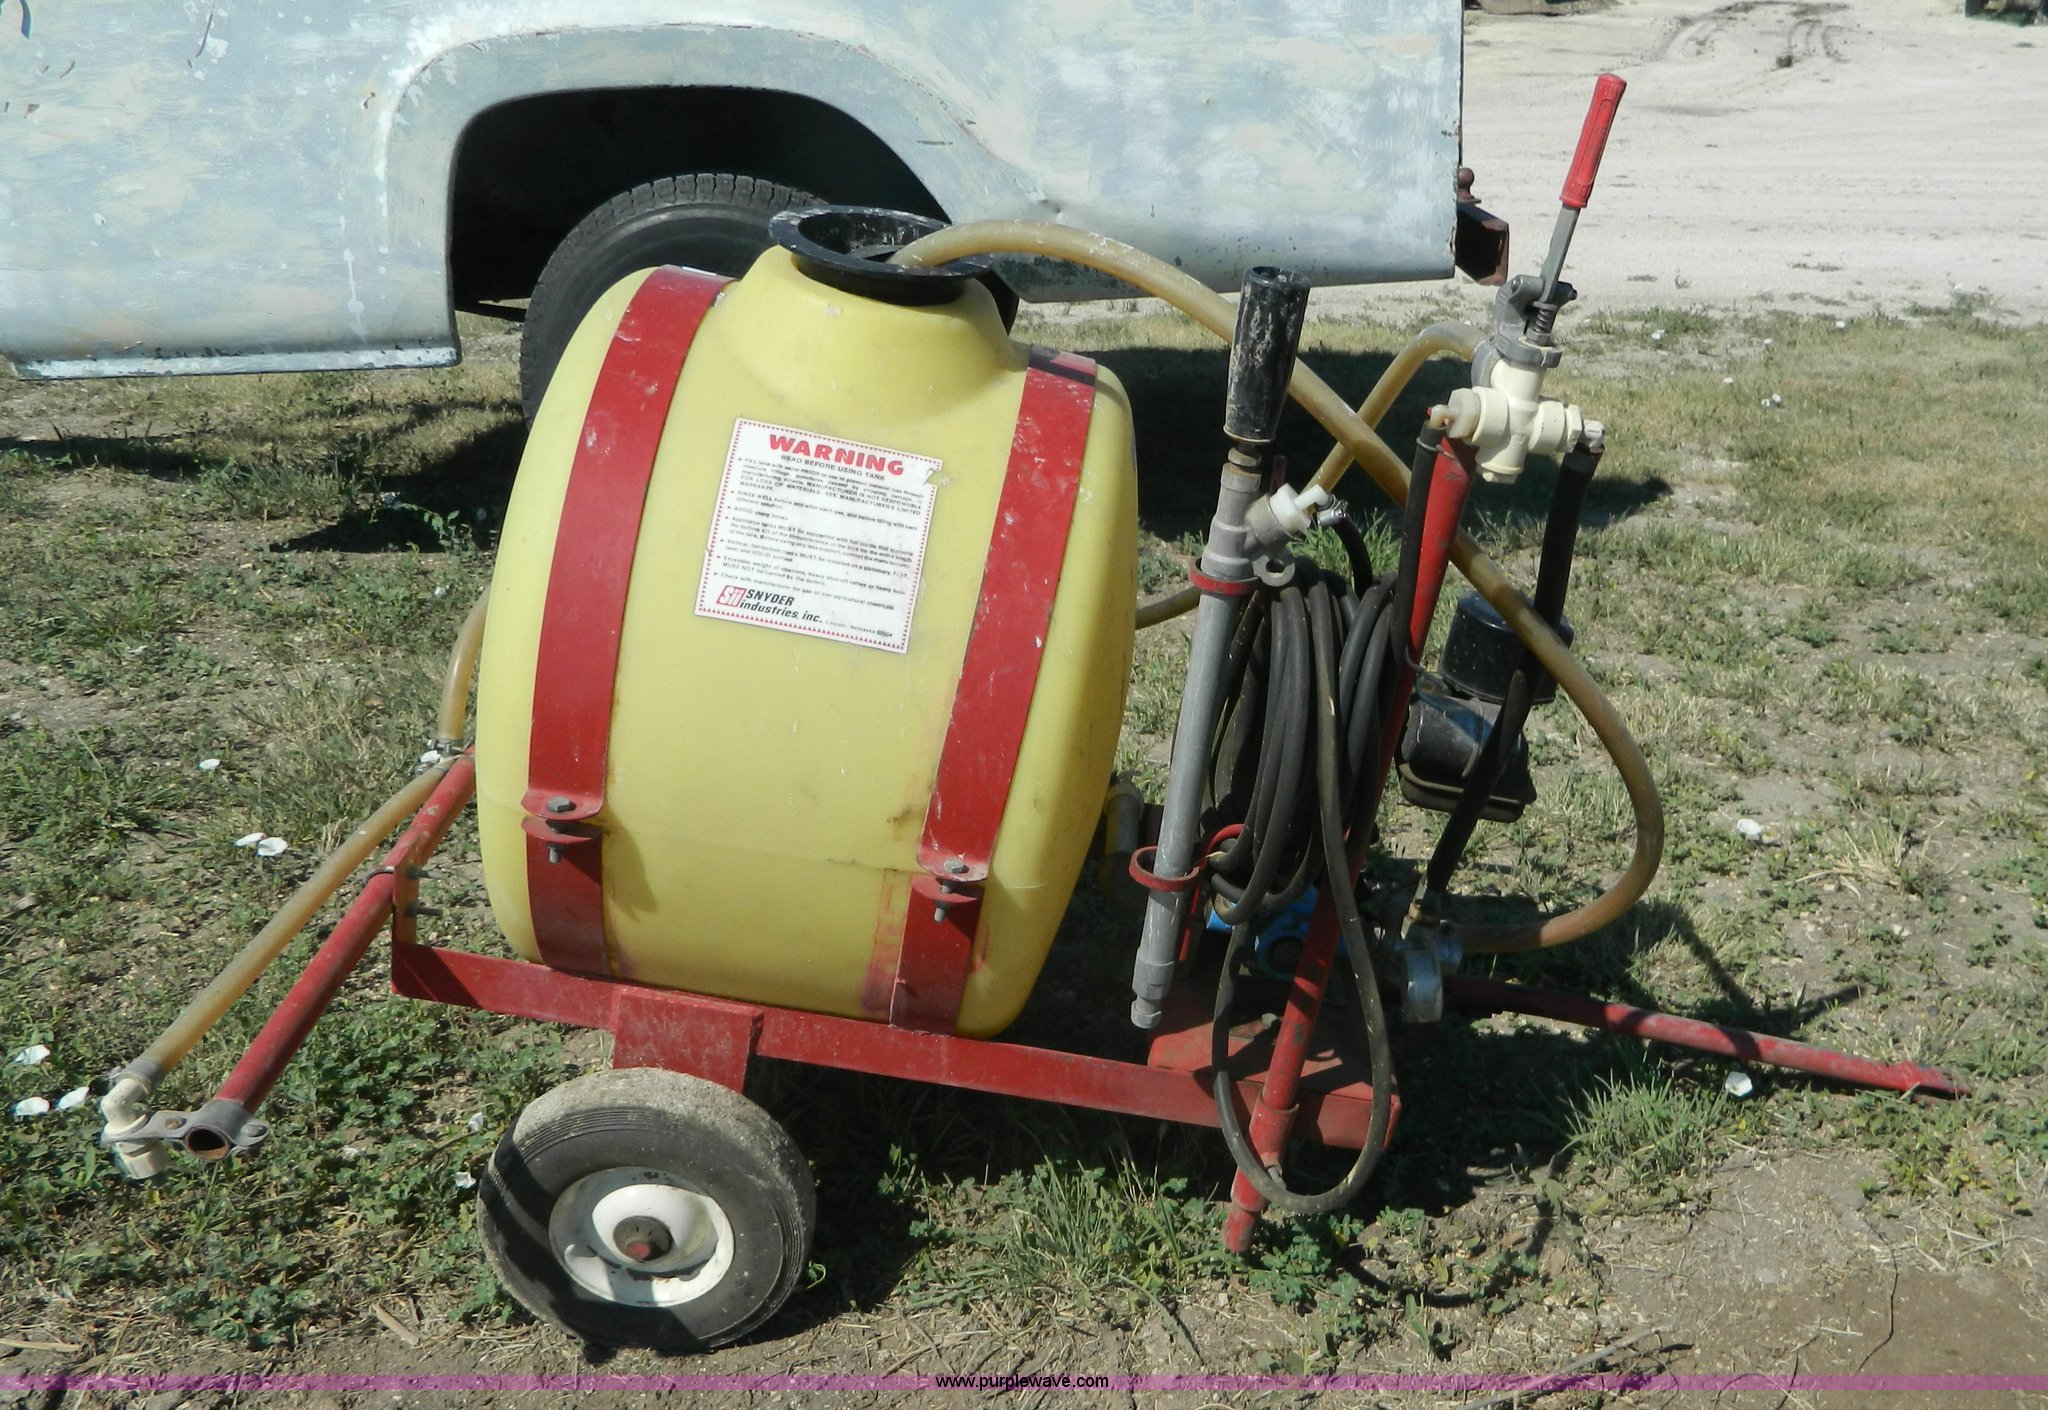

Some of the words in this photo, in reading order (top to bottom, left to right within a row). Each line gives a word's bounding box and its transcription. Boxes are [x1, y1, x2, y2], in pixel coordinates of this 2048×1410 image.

[770, 434, 904, 475] WARNING
[781, 454, 802, 463] READ
[805, 460, 835, 470] BEFORE
[838, 466, 862, 476] USING
[866, 472, 885, 480] TANK
[746, 589, 794, 606] SNYDER
[802, 611, 823, 623] inc.
